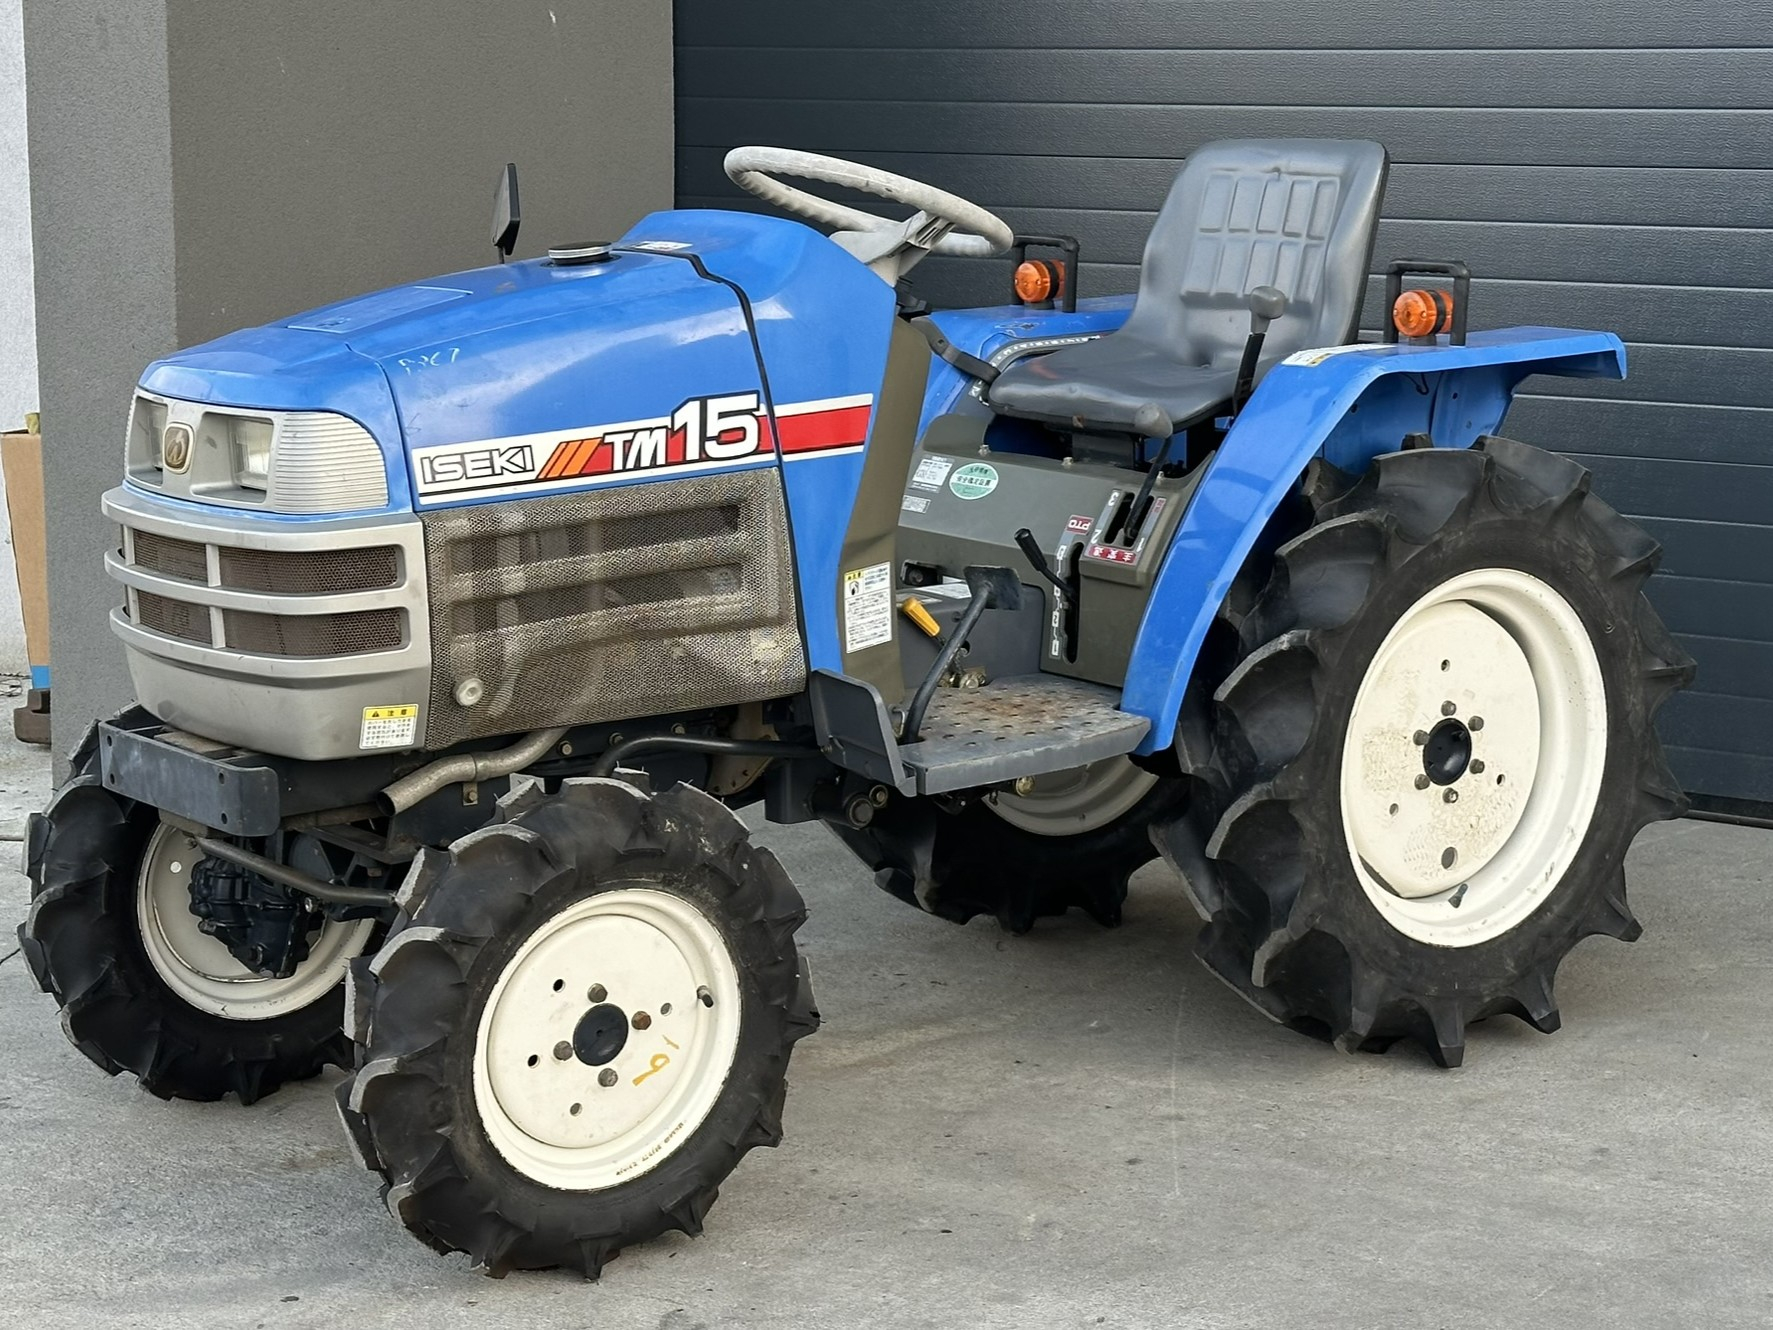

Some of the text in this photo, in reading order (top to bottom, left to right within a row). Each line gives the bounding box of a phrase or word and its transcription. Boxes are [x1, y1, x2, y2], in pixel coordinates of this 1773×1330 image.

[421, 445, 536, 485] ISEKI
[1106, 491, 1120, 507] 3
[1067, 518, 1093, 532] PTO
[1090, 528, 1102, 545] 2
